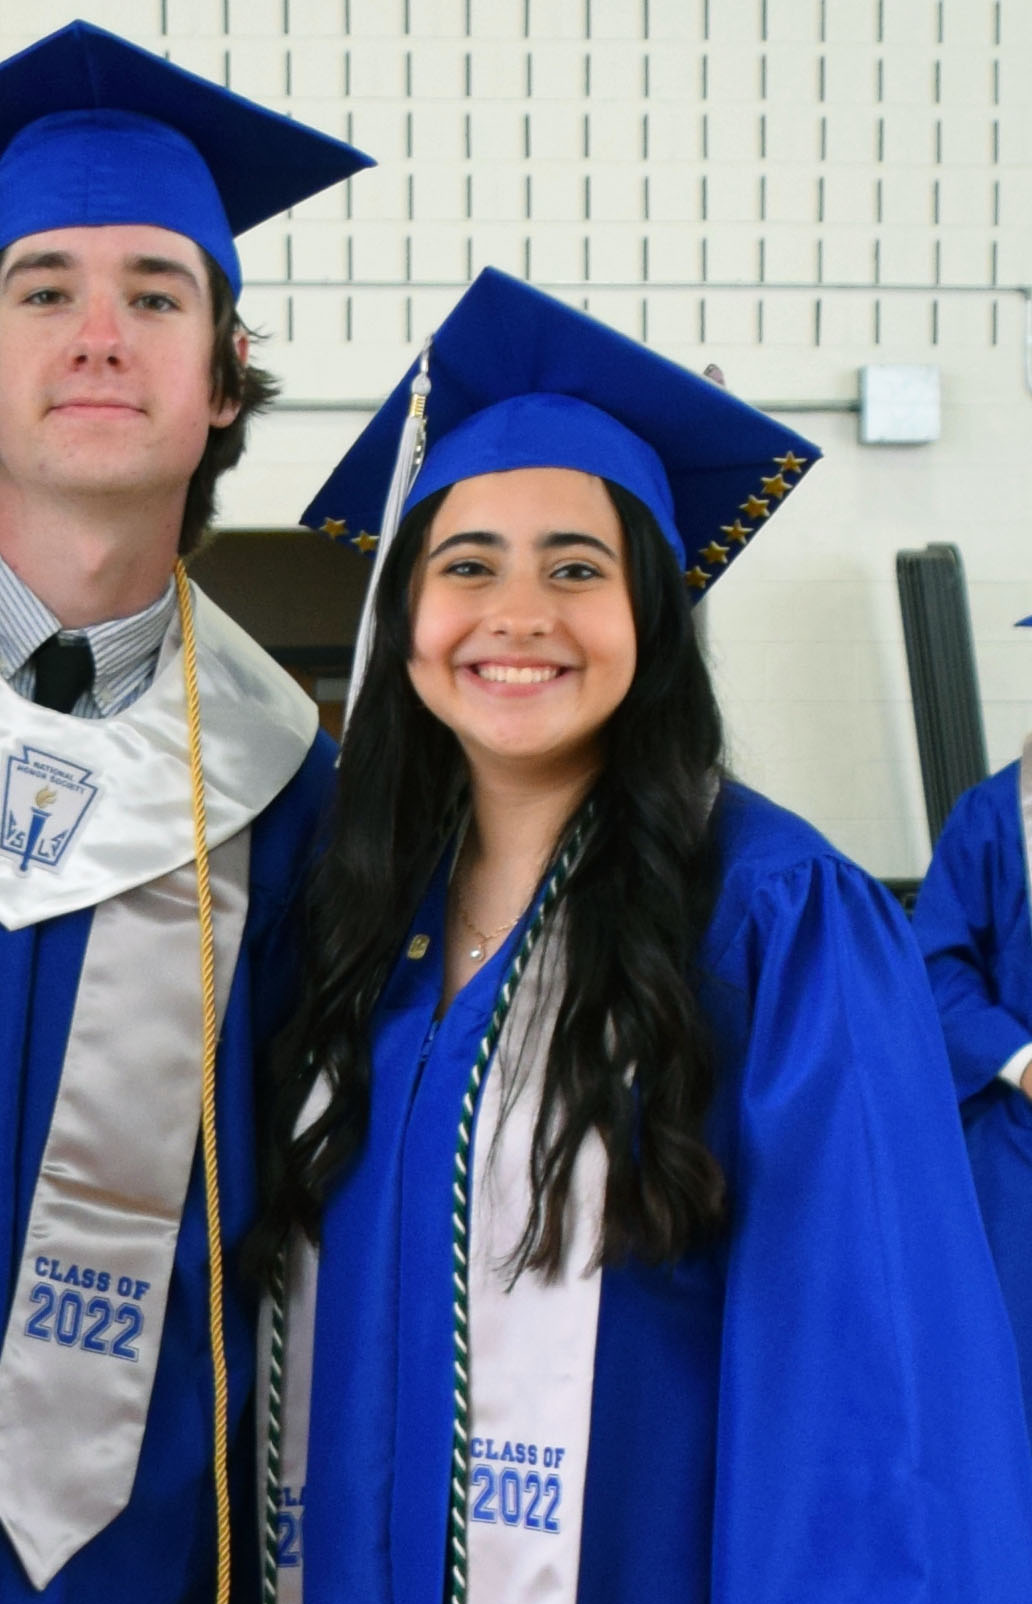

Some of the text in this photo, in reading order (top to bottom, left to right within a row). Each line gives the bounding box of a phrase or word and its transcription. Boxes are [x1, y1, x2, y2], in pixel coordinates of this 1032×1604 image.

[17, 765, 86, 794] HONOR SOCIETY
[33, 762, 74, 780] NATIONAL
[35, 1256, 151, 1300] CLASS OF
[24, 1281, 145, 1362] 2022
[471, 1437, 566, 1469] CLASS OF
[471, 1463, 561, 1535] 2022
